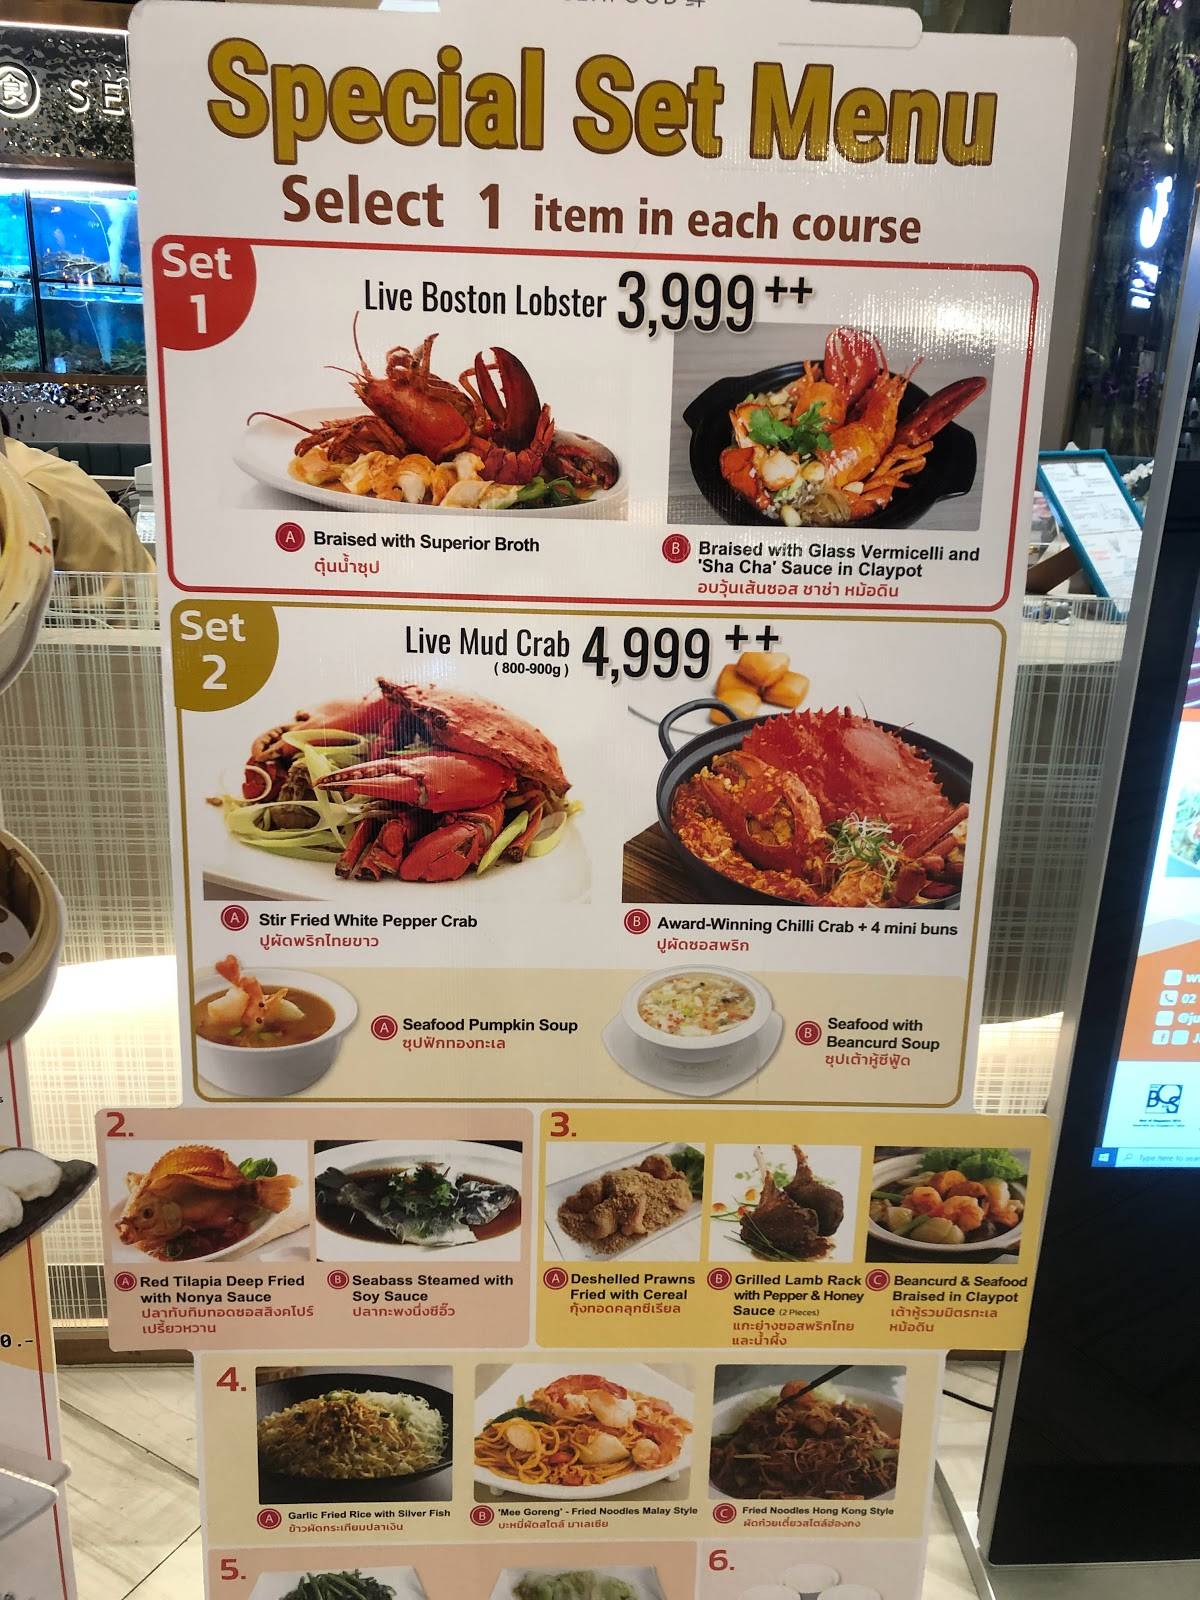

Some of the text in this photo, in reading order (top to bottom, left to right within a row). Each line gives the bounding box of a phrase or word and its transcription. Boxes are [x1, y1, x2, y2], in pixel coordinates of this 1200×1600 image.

[206, 37, 999, 166] Special Set Menu
[282, 174, 921, 244] Select 1 item in each course
[161, 242, 233, 282] Set
[364, 279, 413, 311] Live
[422, 281, 507, 315] Boston
[515, 283, 607, 319] Lobster
[189, 294, 207, 334] 1
[313, 531, 377, 547] Braised
[381, 534, 416, 548] with
[420, 534, 491, 553] Superior
[494, 536, 540, 552] Broth
[699, 541, 763, 557] Braised
[768, 542, 803, 558] with
[808, 543, 856, 559] Glass
[861, 544, 944, 561] Vermicelli
[948, 547, 980, 561] and
[698, 558, 923, 581] 'Sha Cha' Sauce in Claypot
[845, 582, 899, 598] หม้อดิน
[179, 610, 247, 642] Set
[405, 625, 451, 655] Live
[459, 627, 508, 656] Mud
[515, 628, 571, 659] Crab
[201, 654, 228, 690] 2
[259, 912, 286, 927] Stir
[290, 913, 330, 927] Fried
[333, 913, 379, 928] White
[382, 914, 436, 930] Pepper
[441, 914, 478, 928] Crab
[657, 917, 772, 934] Award-Winning
[776, 918, 815, 933] Chilli
[818, 920, 854, 934] Crab
[858, 922, 868, 933] +
[871, 921, 880, 934] 4
[884, 921, 916, 936] mini
[920, 922, 959, 936] buns
[402, 1018, 465, 1031] Seafood
[469, 1018, 535, 1034] Pumpkin
[538, 1019, 578, 1034] Soup
[827, 1017, 889, 1031] Seafood
[892, 1019, 923, 1031] with
[826, 1036, 940, 1052] Beancurd Soup
[105, 1111, 135, 1138] 2.
[549, 1111, 578, 1138] 3.
[140, 1276, 169, 1288] Red
[173, 1275, 222, 1289] Tilapia
[226, 1275, 264, 1289] Deep
[268, 1275, 305, 1286] Fried
[352, 1274, 413, 1286] Seabass
[417, 1274, 480, 1286] Steamed
[484, 1274, 514, 1286] with
[571, 1273, 640, 1285] Deshelled
[644, 1274, 695, 1285] Prawns
[735, 1274, 781, 1285] Grilled
[785, 1275, 824, 1286] Lamb
[827, 1275, 862, 1286] Rack
[894, 1275, 957, 1286] Beancurd
[960, 1276, 970, 1286] &
[974, 1276, 1028, 1288] Seafood
[140, 1291, 272, 1305] with Nonya Sauce
[352, 1290, 429, 1304] Soy Sauce
[570, 1289, 688, 1300] Fried with Cereal
[734, 1290, 865, 1304] with Pepper & Honey
[892, 1291, 1019, 1305] Braised in Claypot
[733, 1305, 820, 1317] Sauce (2 Pieces)
[216, 1366, 247, 1392] 4.
[288, 1511, 318, 1520] Garlic
[321, 1511, 347, 1519] Fried
[349, 1510, 372, 1519] Rice
[374, 1509, 396, 1518] with
[398, 1509, 427, 1518] Silver
[429, 1509, 451, 1517] Fish
[571, 1507, 597, 1516] Fried
[599, 1507, 640, 1516] Noodles
[642, 1507, 671, 1517] Malay
[673, 1506, 698, 1516] Style
[742, 1506, 768, 1515] Fried
[769, 1506, 810, 1515] Noodles
[812, 1506, 839, 1516] Hong
[841, 1507, 867, 1517] Kong
[869, 1507, 894, 1516] Style
[708, 1549, 735, 1571] 6.
[220, 1558, 246, 1581] 5.
